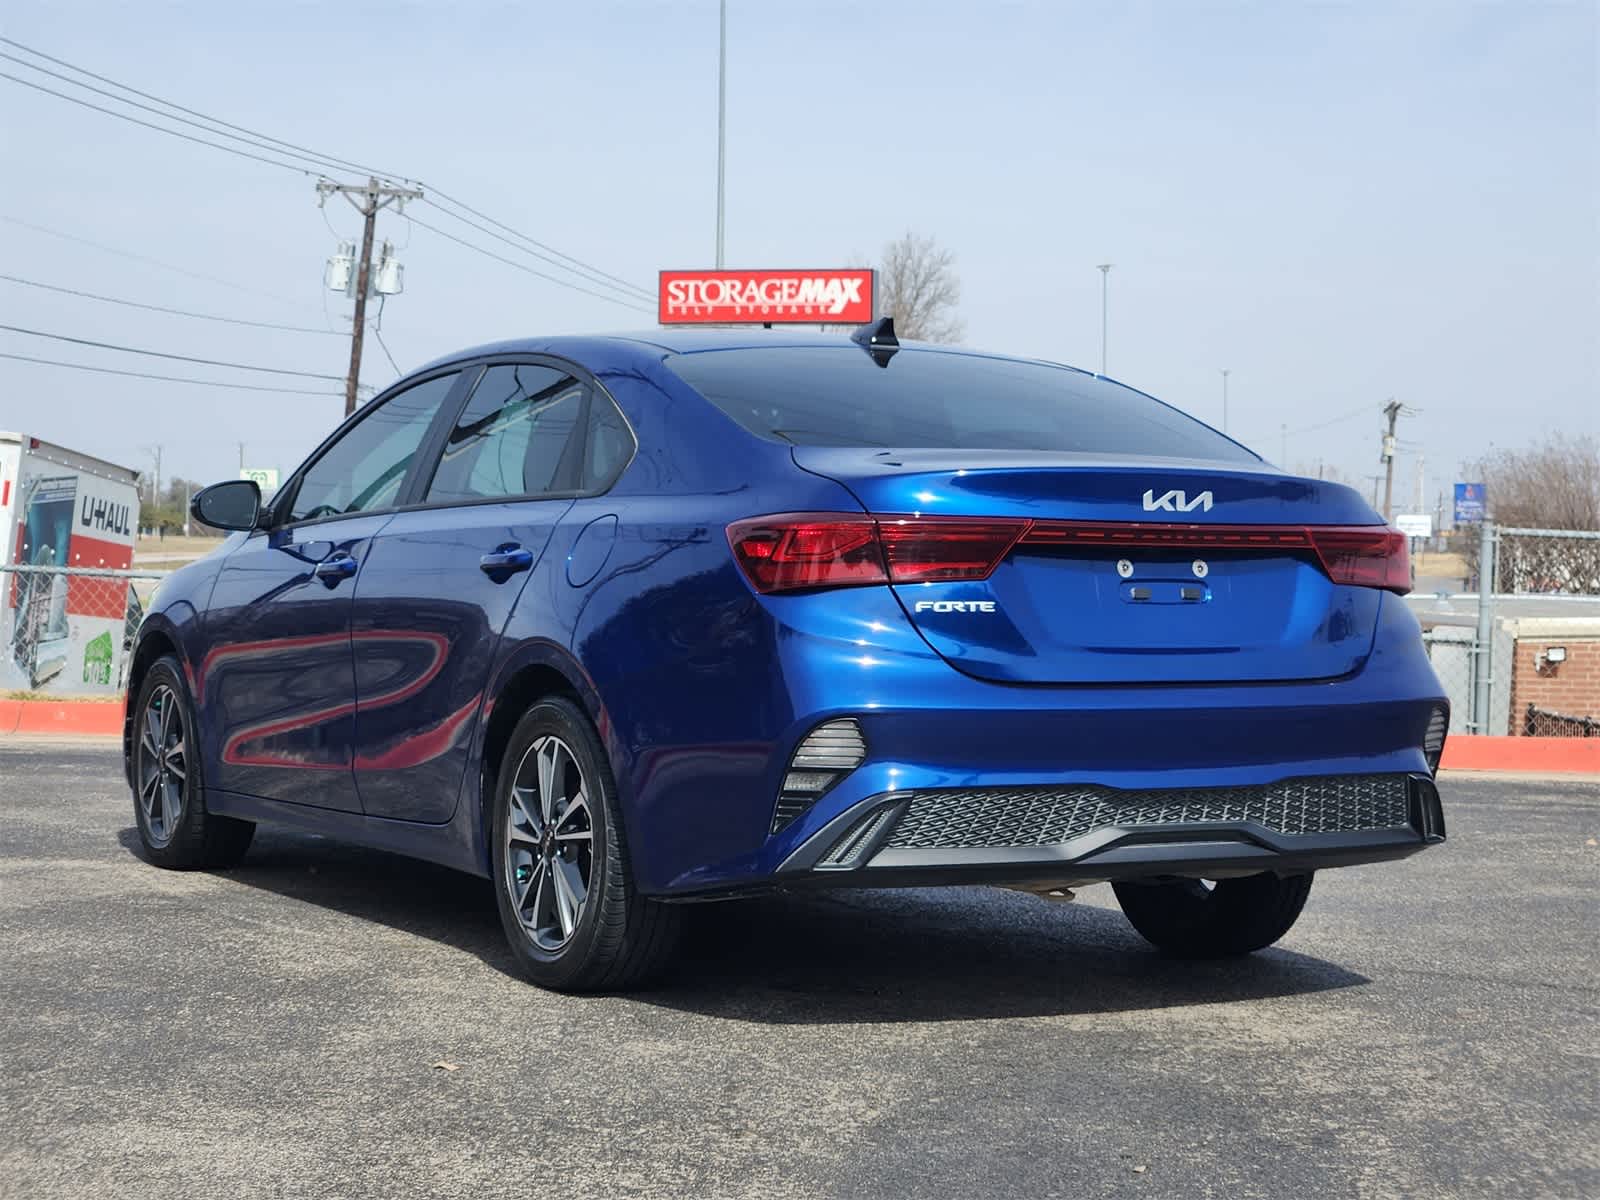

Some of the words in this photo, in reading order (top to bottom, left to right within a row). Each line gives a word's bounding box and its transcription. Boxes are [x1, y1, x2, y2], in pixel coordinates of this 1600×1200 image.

[1143, 489, 1213, 512] KIA
[81, 495, 130, 536] U-HAUL
[915, 601, 996, 613] FORTE
